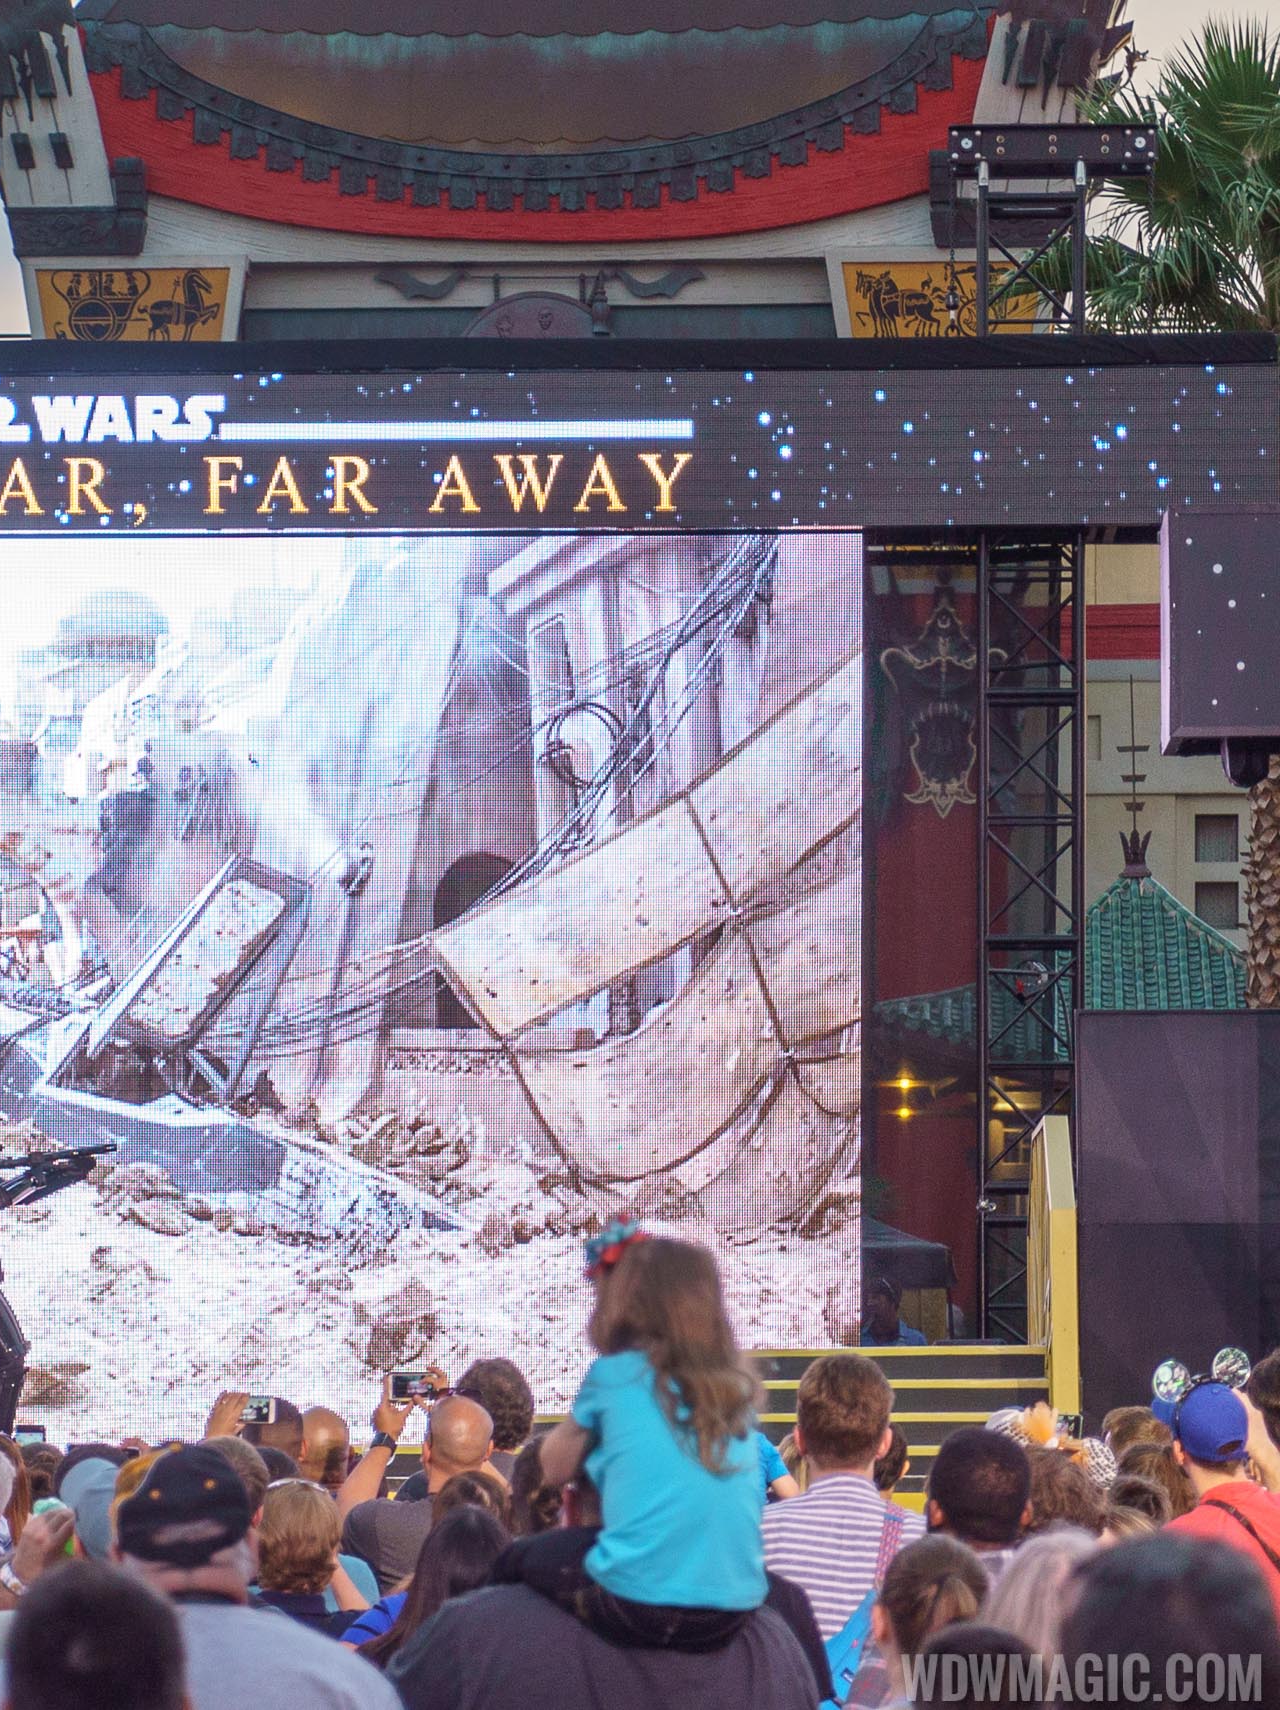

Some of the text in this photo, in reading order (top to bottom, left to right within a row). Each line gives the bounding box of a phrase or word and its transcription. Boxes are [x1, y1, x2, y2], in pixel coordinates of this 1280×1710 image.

[31, 395, 225, 443] WARS
[203, 455, 379, 514] FAR
[428, 453, 692, 513] AWAY
